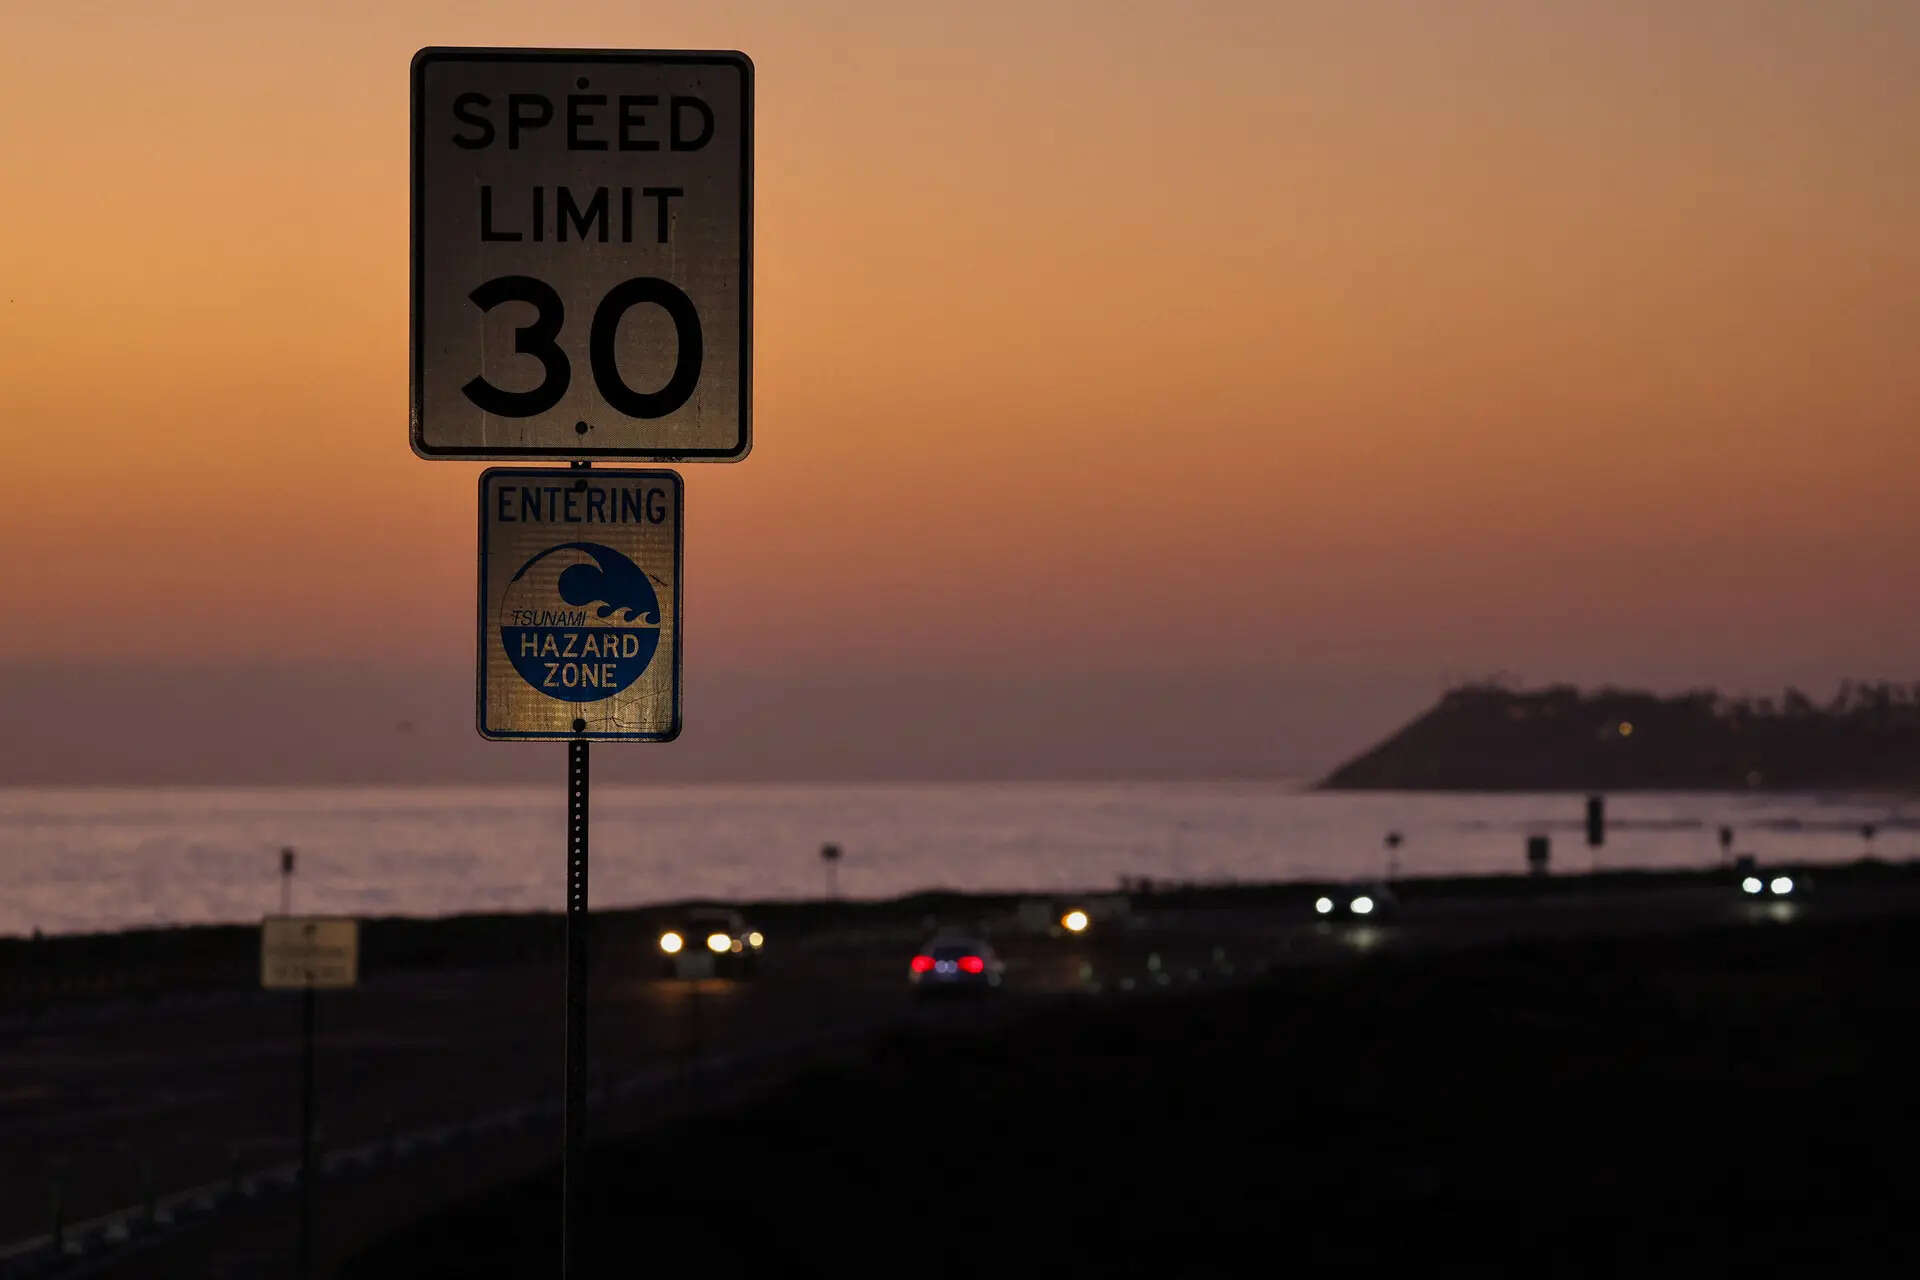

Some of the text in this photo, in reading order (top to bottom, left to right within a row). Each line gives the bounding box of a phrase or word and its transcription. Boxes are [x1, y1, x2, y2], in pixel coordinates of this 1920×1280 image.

[452, 92, 715, 152] SPEED
[480, 185, 684, 243] LIMIT
[461, 275, 703, 419] 30
[498, 486, 666, 524] ENTERING
[512, 609, 587, 627] TSUNAMI
[521, 632, 640, 658] HAZARD
[543, 662, 618, 688] ZONE
